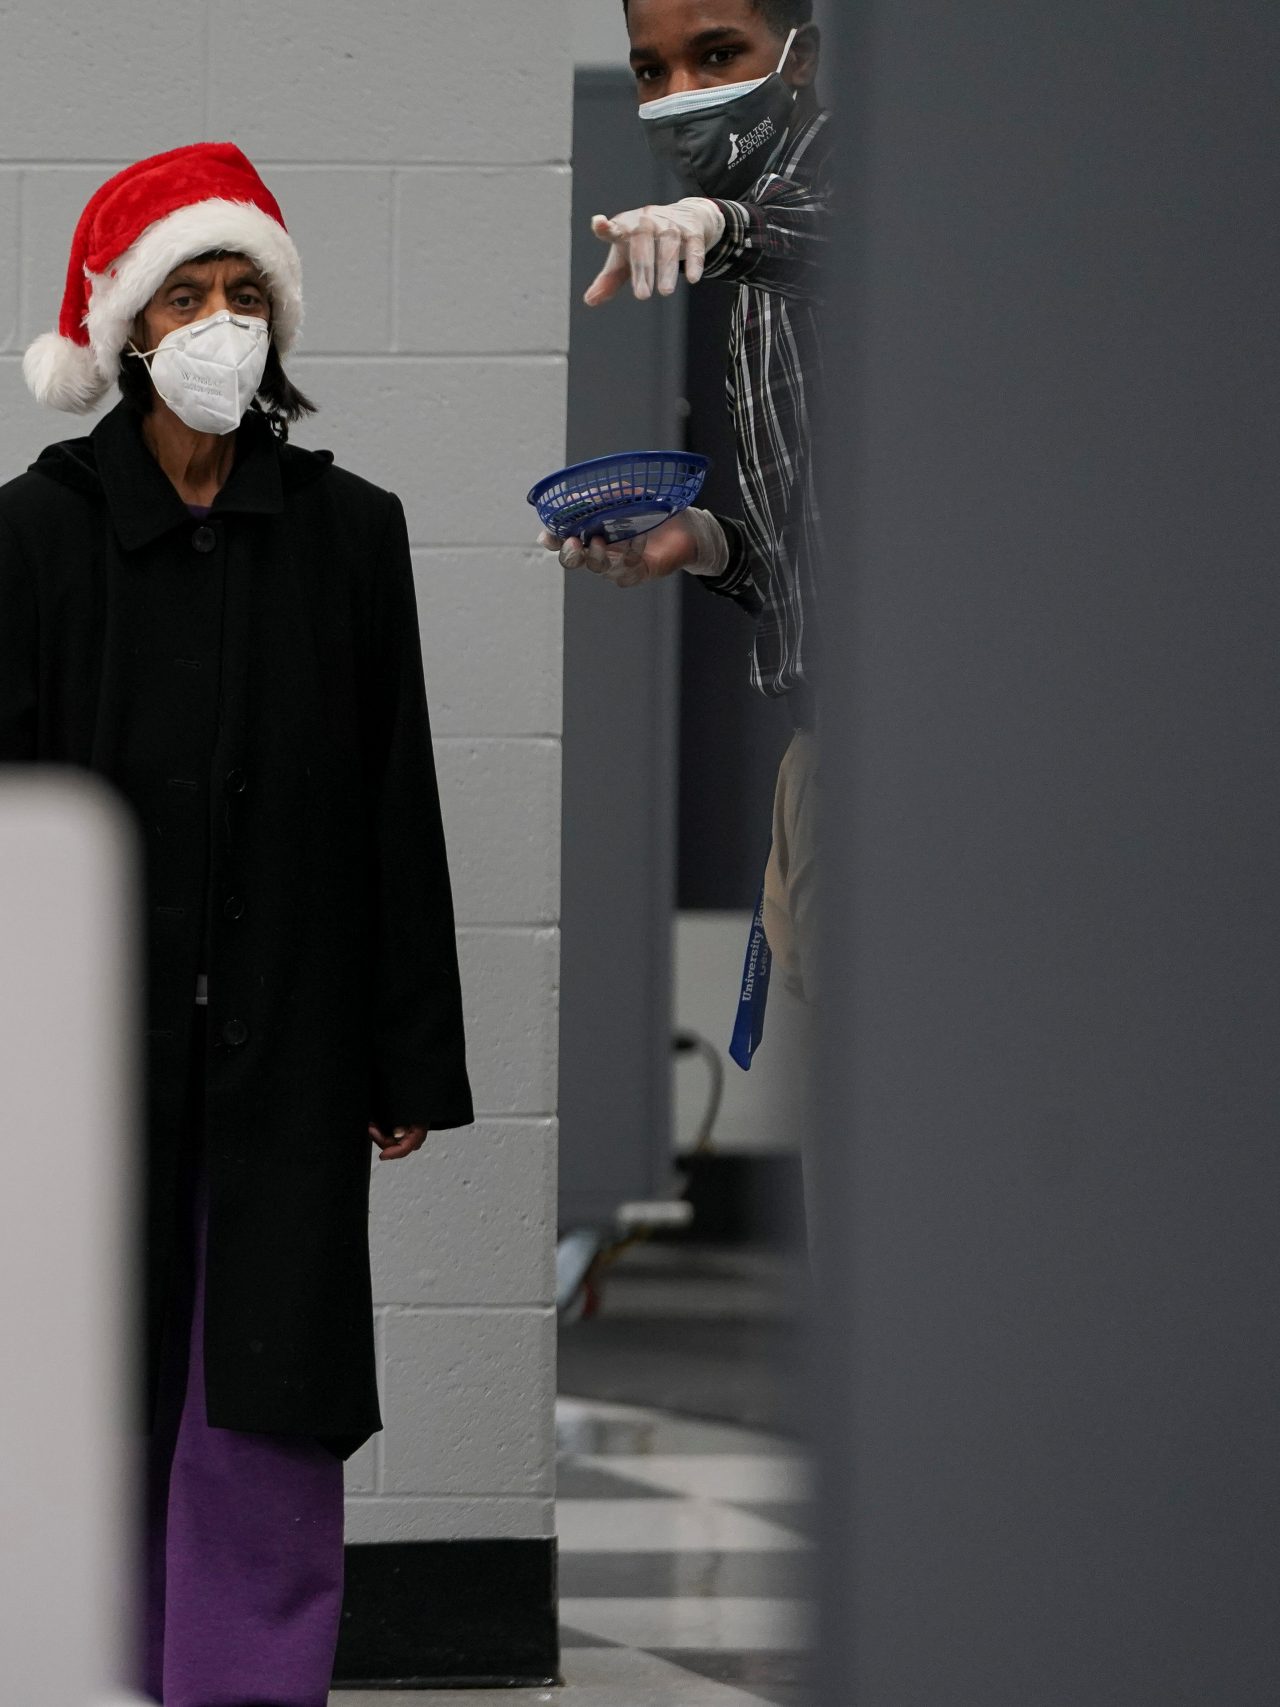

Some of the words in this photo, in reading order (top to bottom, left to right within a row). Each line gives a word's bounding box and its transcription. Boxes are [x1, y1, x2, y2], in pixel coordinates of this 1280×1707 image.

[738, 116, 772, 147] FULTON
[740, 124, 773, 153] COUNTY
[727, 154, 747, 170] BOARD
[747, 147, 755, 156] OF
[742, 930, 762, 1001] University
